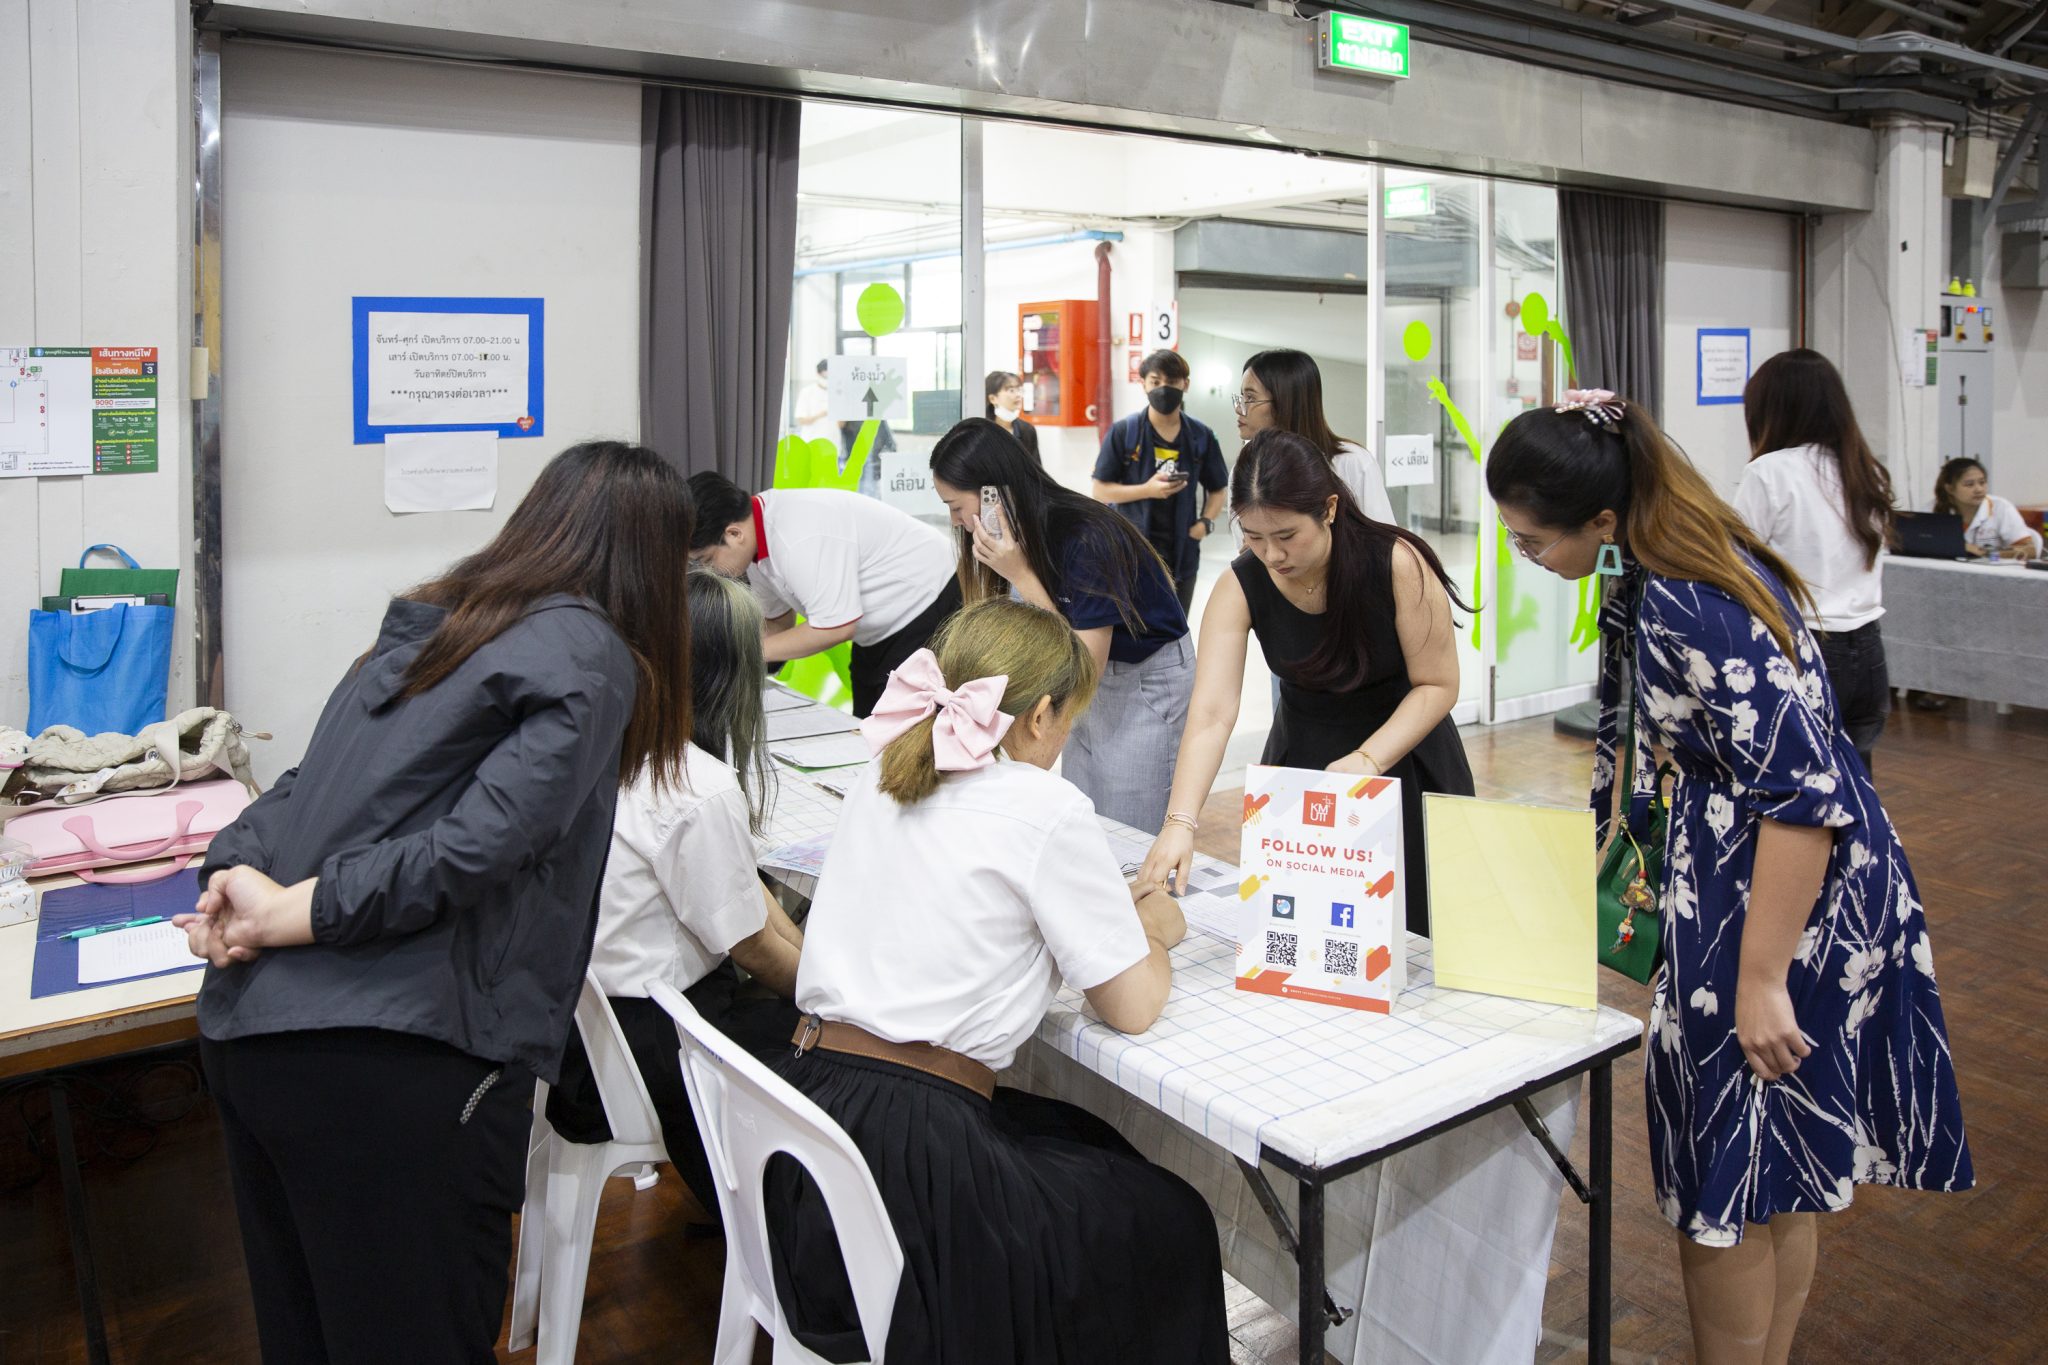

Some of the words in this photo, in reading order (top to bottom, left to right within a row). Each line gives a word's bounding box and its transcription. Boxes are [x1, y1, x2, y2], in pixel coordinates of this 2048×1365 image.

[1340, 18, 1398, 48] EXIT
[1337, 42, 1404, 72] ทางออก
[1159, 313, 1171, 341] 3
[421, 334, 460, 345] เปิดบริการ
[388, 351, 406, 361] เสาร์
[409, 351, 449, 361] เปิดบริการ
[146, 366, 154, 374] 3
[414, 368, 487, 379] วันอาทิตย์ปิดบริการ
[890, 468, 926, 492] เลื่อน
[1261, 838, 1336, 859] FOLLOW
[1343, 848, 1373, 863] US!
[1266, 858, 1282, 868] ON
[1286, 861, 1326, 874] SOCIAL
[1330, 867, 1366, 879] MEDIA
